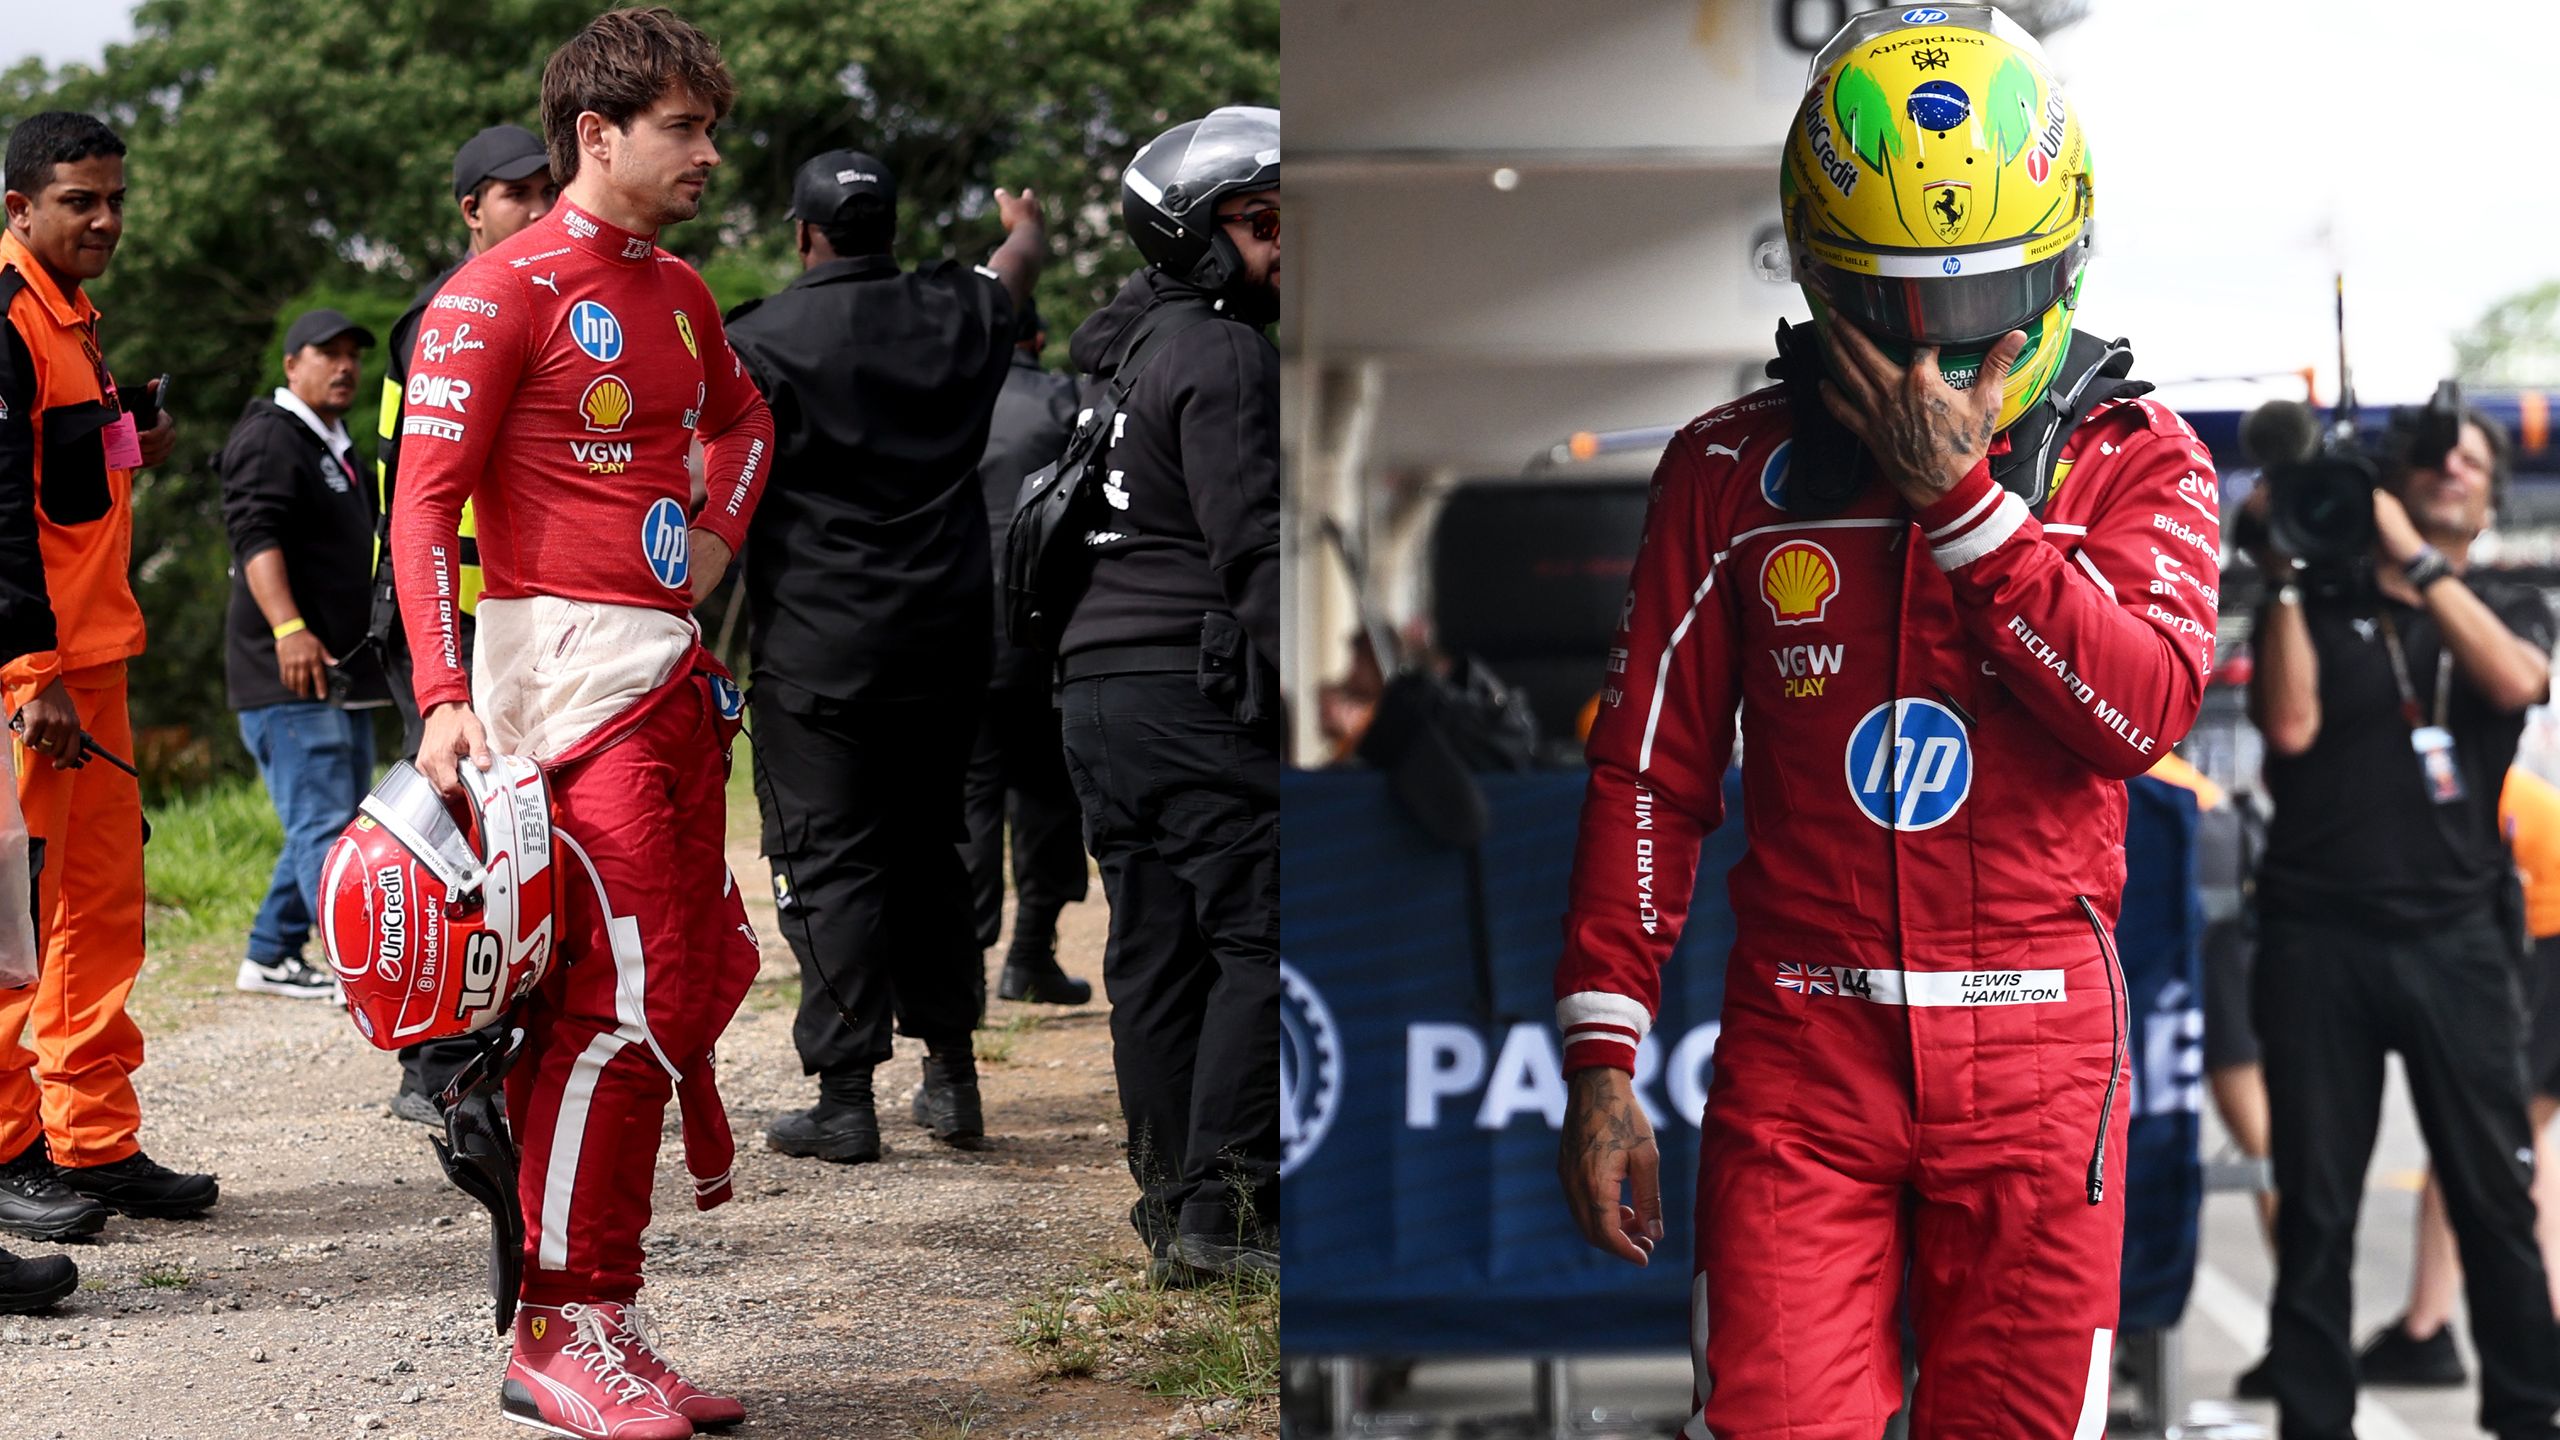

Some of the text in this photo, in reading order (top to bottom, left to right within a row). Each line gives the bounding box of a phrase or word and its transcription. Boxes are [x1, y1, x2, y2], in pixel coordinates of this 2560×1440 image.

[1907, 9, 1944, 24] hp
[1869, 36, 1984, 59] perplexity
[1807, 95, 1858, 197] UniCredit
[564, 210, 599, 235] PERONI
[529, 247, 572, 262] TECHNOLOGY
[2031, 229, 2077, 255] RICHARD MILLE
[1844, 256, 1870, 267] MILLE
[1944, 257, 1960, 274] hp
[439, 295, 498, 318] GENESYS
[580, 301, 615, 361] hp
[1740, 397, 1787, 412] TECHN
[570, 441, 633, 462] VGW
[588, 462, 625, 474] PLAY
[726, 438, 764, 517] RICHARD MILLE
[652, 499, 686, 587] hp
[431, 546, 458, 669] RICHARD MILLE
[1770, 644, 1844, 678] VGW
[1785, 678, 1825, 698] PLAY
[2008, 615, 2156, 755] RICHARD MILLE
[1862, 699, 1962, 827] hp
[515, 794, 547, 855] IBM
[379, 867, 404, 960] UniCredit
[421, 895, 438, 976] Bitdefender
[455, 931, 501, 1019] 16
[1841, 969, 2022, 997] 44 LEWIS
[1962, 988, 2059, 1004] HAMILTON
